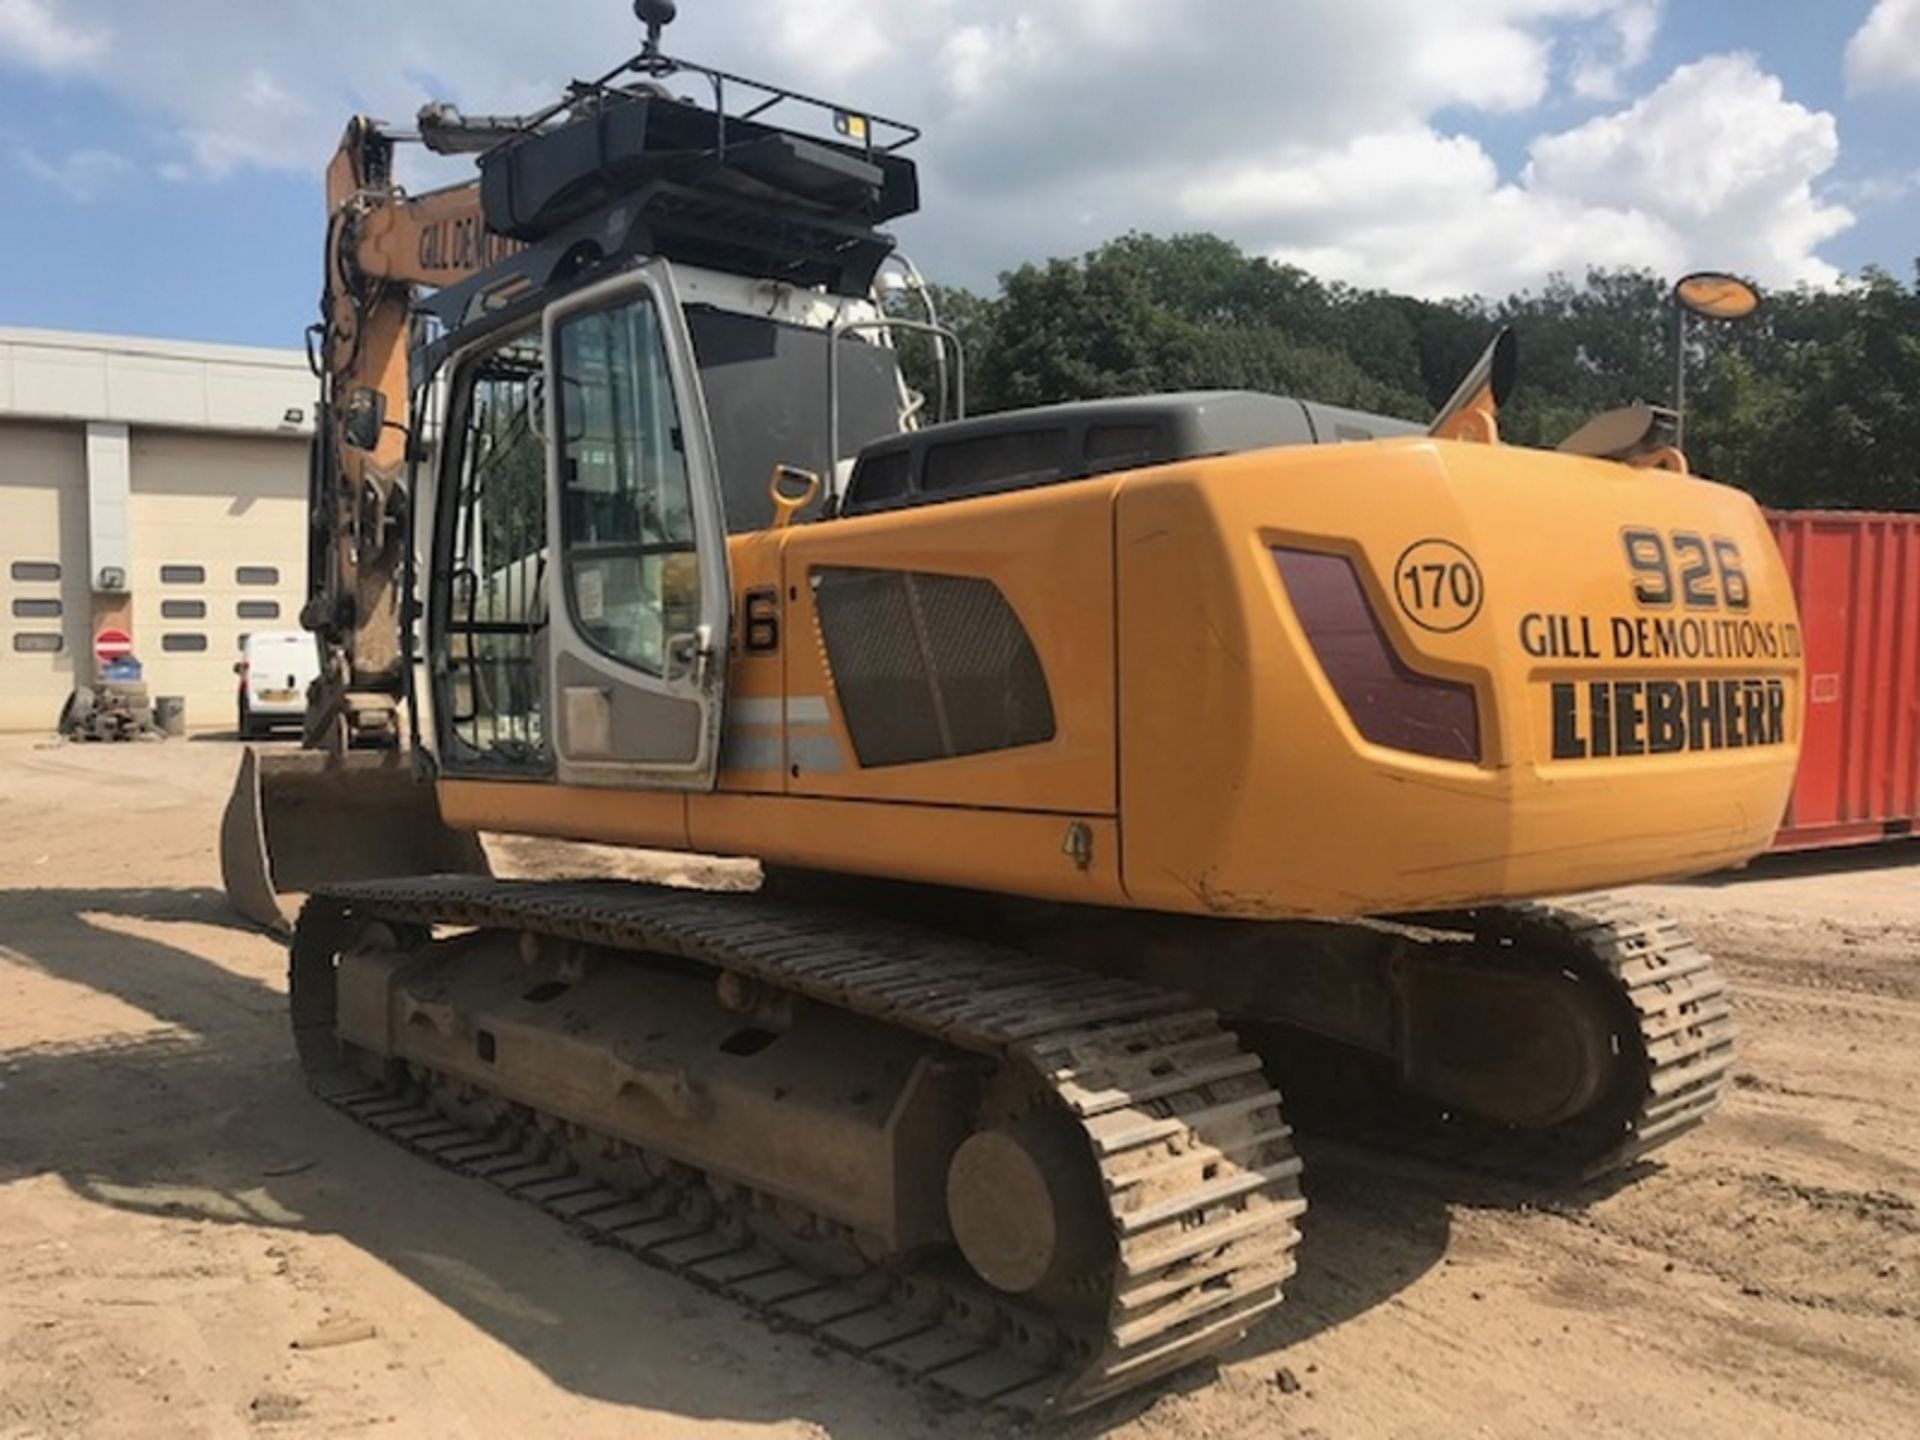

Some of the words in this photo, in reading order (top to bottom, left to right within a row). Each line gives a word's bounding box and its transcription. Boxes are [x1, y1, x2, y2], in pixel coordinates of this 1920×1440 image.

[417, 220, 448, 269] GILL
[1403, 563, 1474, 609] 170
[1621, 526, 1751, 611] 926
[728, 585, 781, 657] 6
[1520, 613, 1600, 658] GILL
[1611, 616, 1777, 659] DEMOLITIONS
[1551, 679, 1784, 760] LIEBHERR
